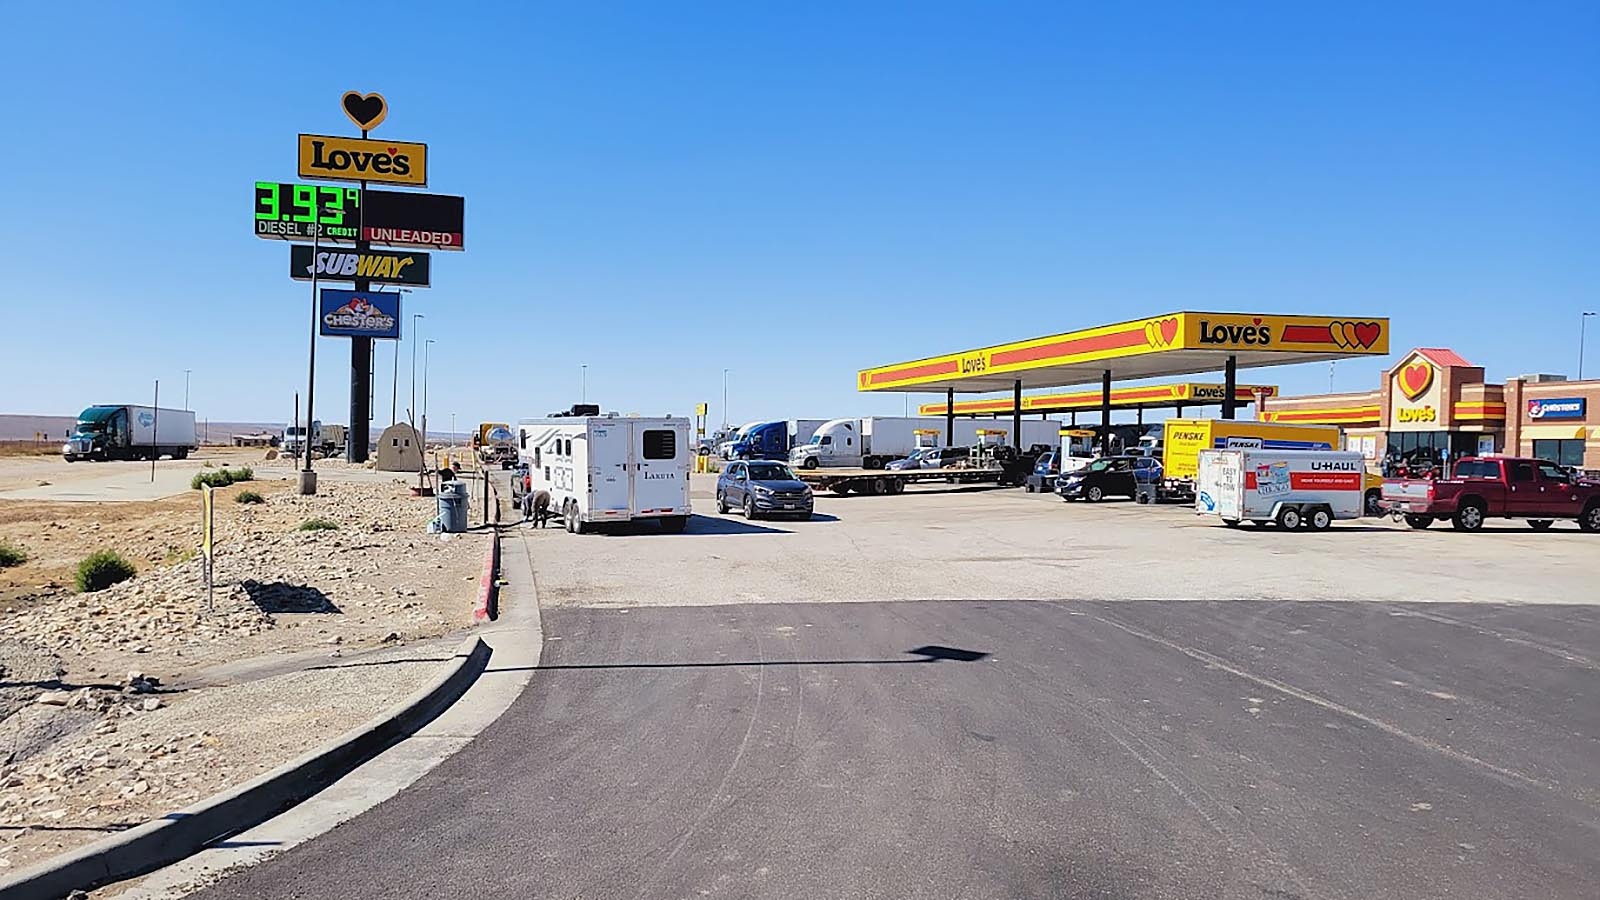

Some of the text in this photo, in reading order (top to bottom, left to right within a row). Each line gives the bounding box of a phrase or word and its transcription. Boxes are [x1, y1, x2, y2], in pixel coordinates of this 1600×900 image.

[258, 220, 302, 235] DIESEL
[326, 226, 358, 237] CREDIT
[370, 227, 453, 245] UNLEADED
[307, 252, 414, 279] SUBWAY
[1173, 432, 1205, 440] PENSKE
[1229, 441, 1260, 449] PENSKE
